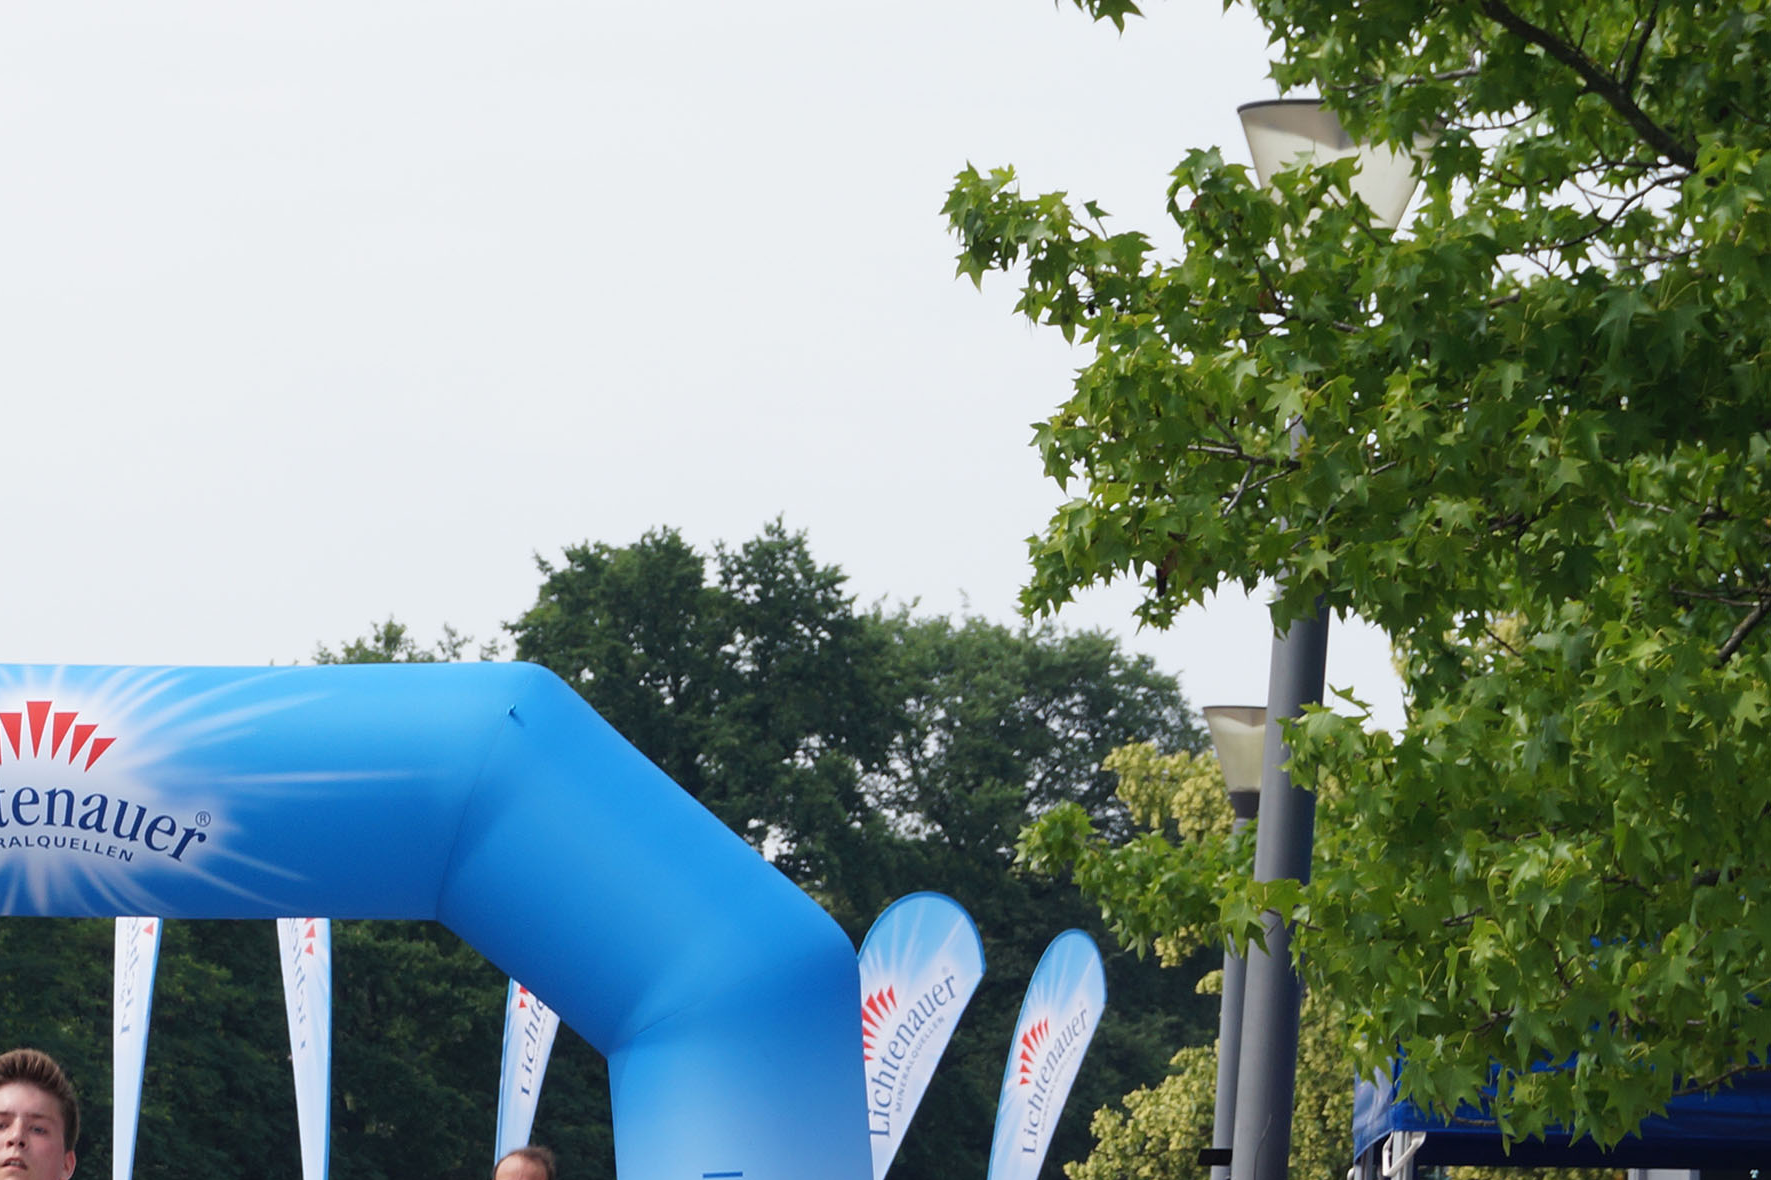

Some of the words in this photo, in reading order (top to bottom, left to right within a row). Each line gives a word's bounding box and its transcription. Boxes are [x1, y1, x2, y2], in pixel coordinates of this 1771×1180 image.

[868, 974, 958, 1139] Lichtenauer
[895, 1015, 945, 1113] MINERALQUELLEN
[1022, 1007, 1088, 1153] Lichtenauer
